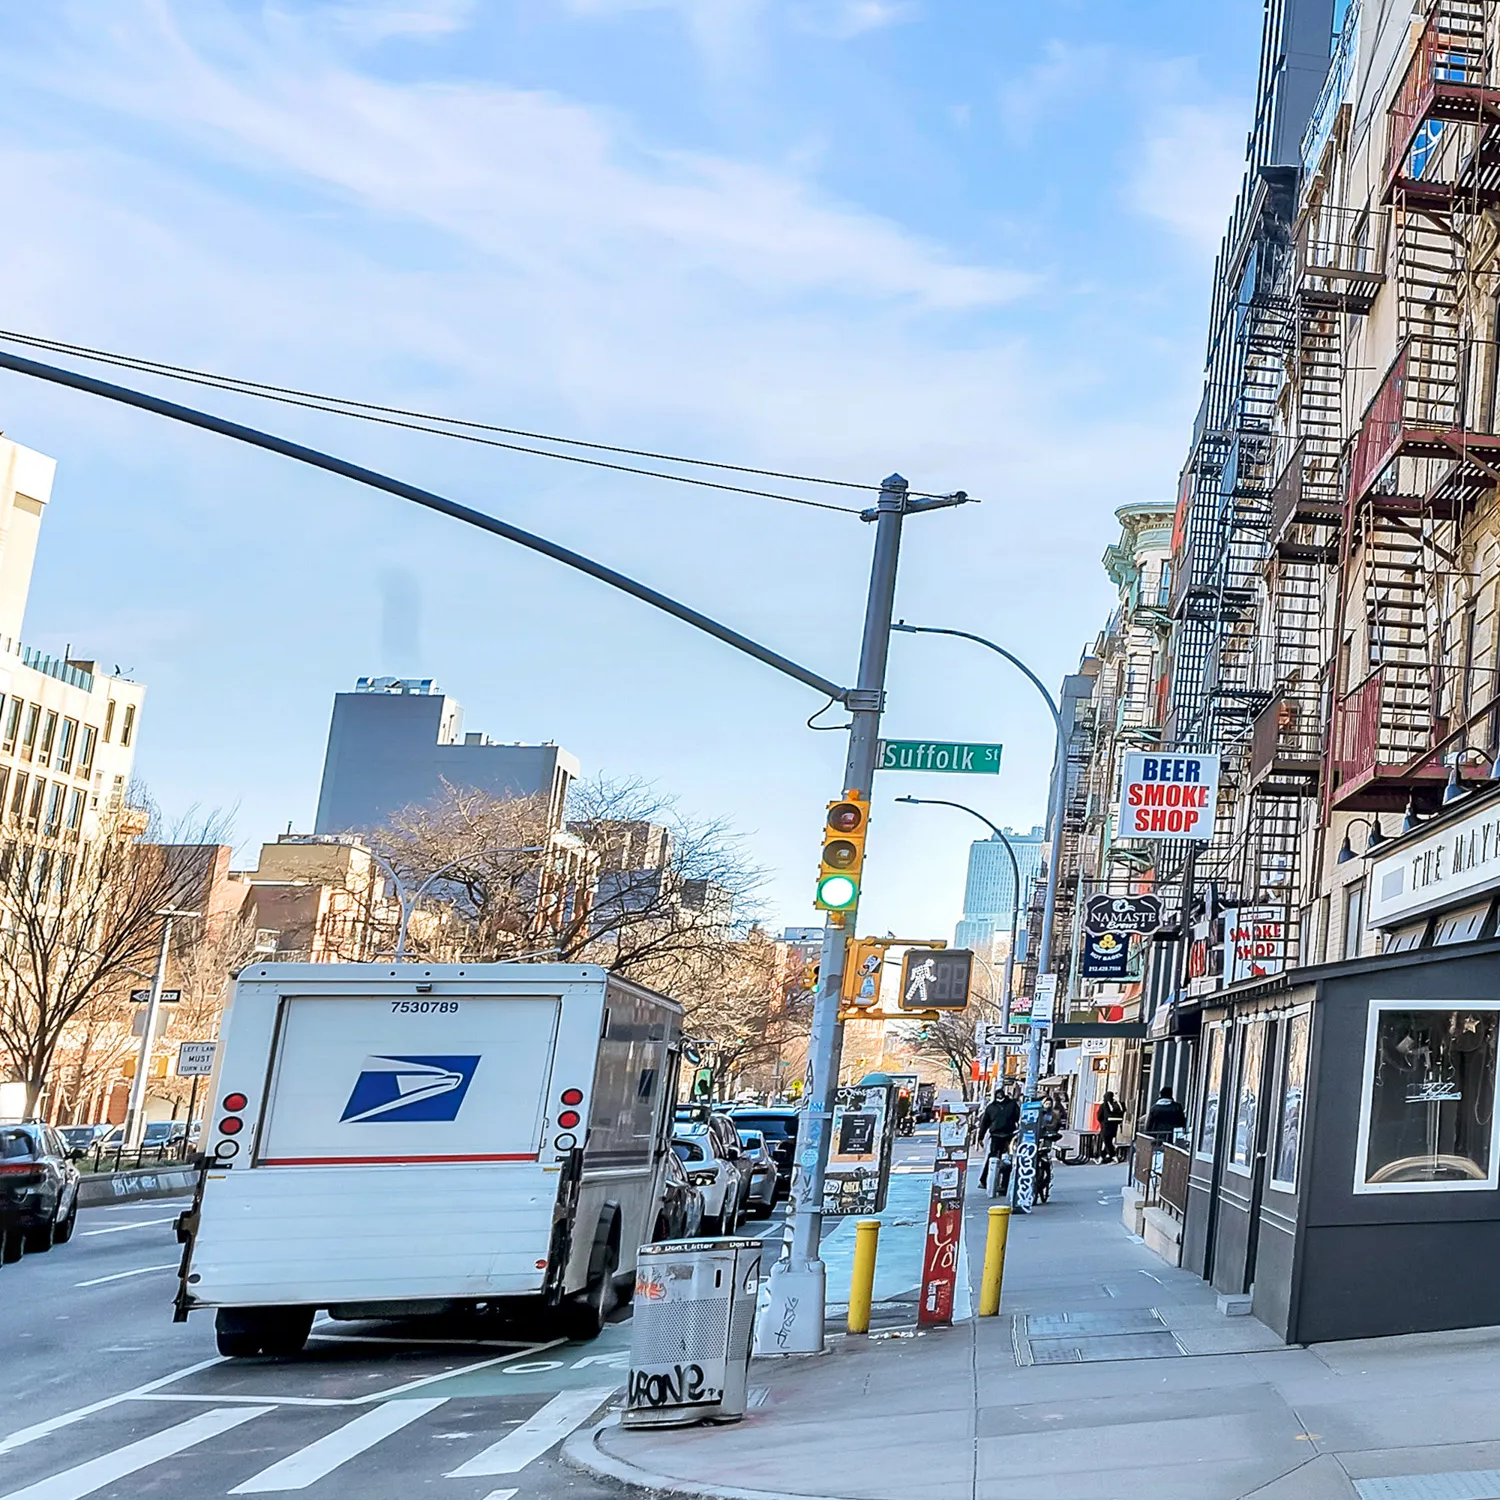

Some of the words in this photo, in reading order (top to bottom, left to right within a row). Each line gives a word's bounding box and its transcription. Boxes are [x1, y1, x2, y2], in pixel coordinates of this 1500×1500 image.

[885, 744, 974, 770] Suffolk
[985, 749, 999, 761] St
[1143, 758, 1201, 782] BEER
[1128, 783, 1210, 807] SMOKE
[1135, 809, 1199, 832] SHOP
[1412, 844, 1446, 891] THE
[1091, 912, 1156, 922] NAMASTE
[1106, 921, 1138, 930] Brews
[1230, 923, 1281, 942] SMOKE
[1237, 942, 1275, 960] SHOP
[391, 1002, 459, 1013] 7530789
